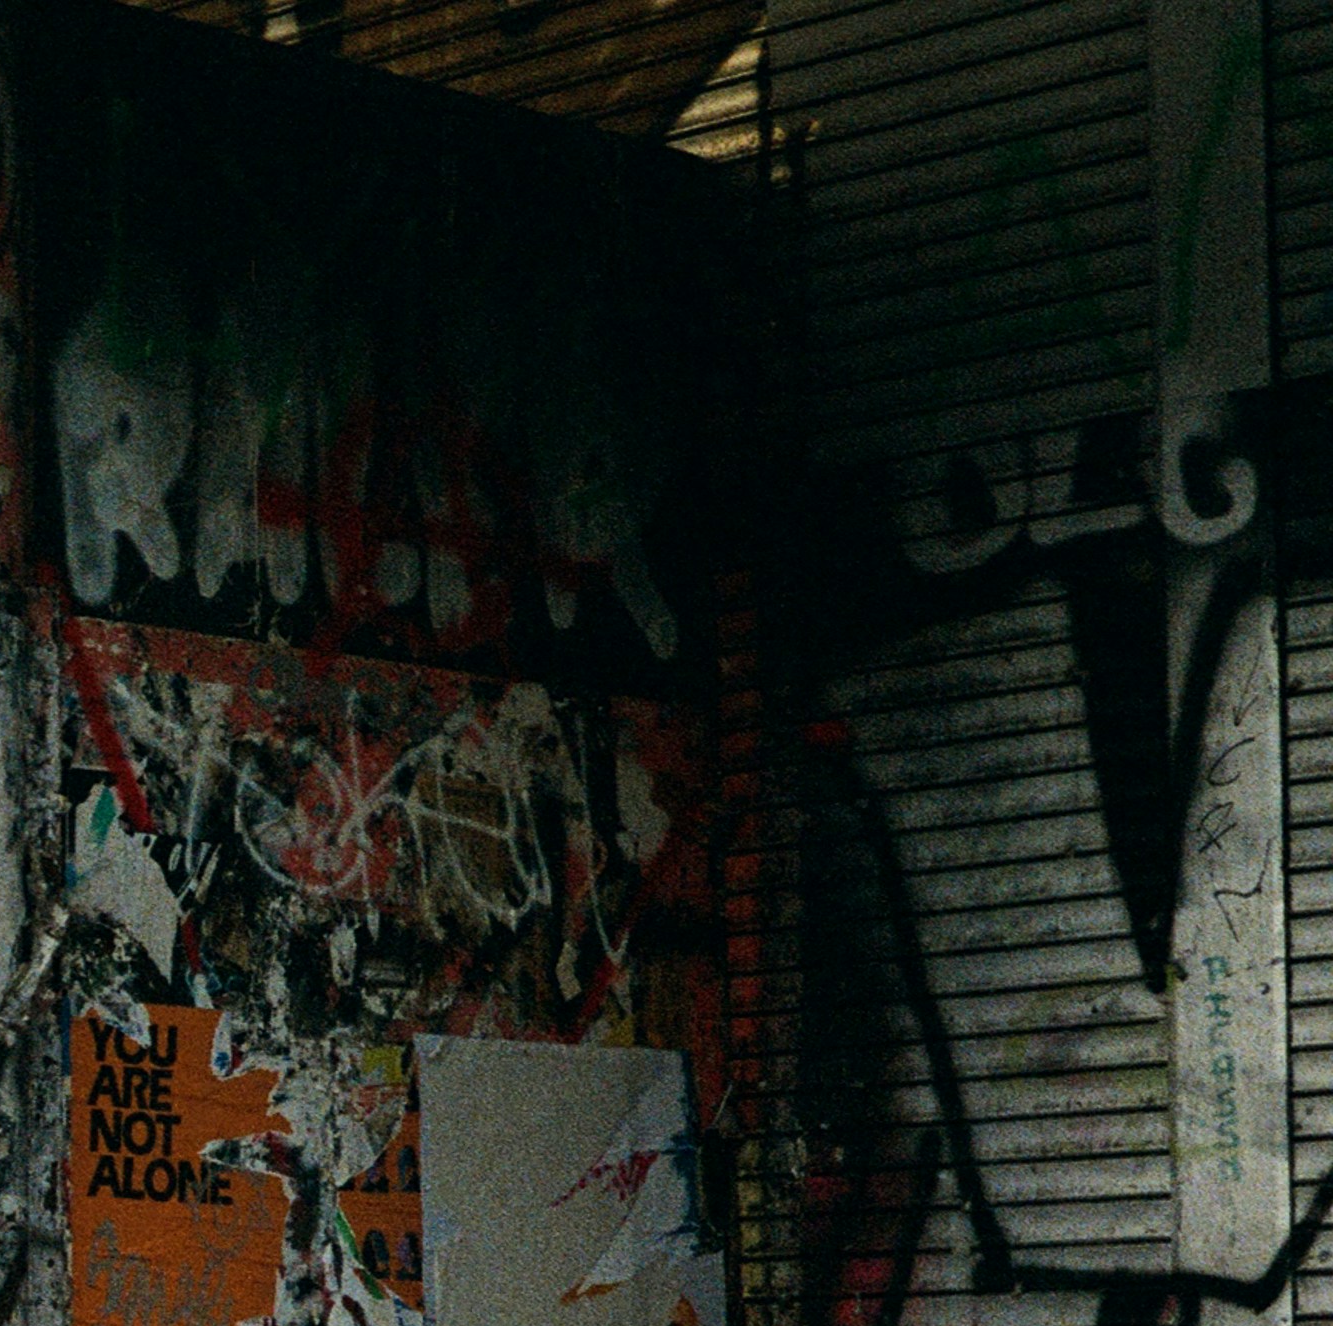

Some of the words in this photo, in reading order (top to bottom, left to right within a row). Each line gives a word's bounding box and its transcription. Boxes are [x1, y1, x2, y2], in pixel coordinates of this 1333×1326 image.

[88, 1018, 178, 1066] YOU
[88, 1068, 174, 1111] ARE
[89, 1109, 182, 1157] NOT
[88, 1156, 236, 1206] ALONE
